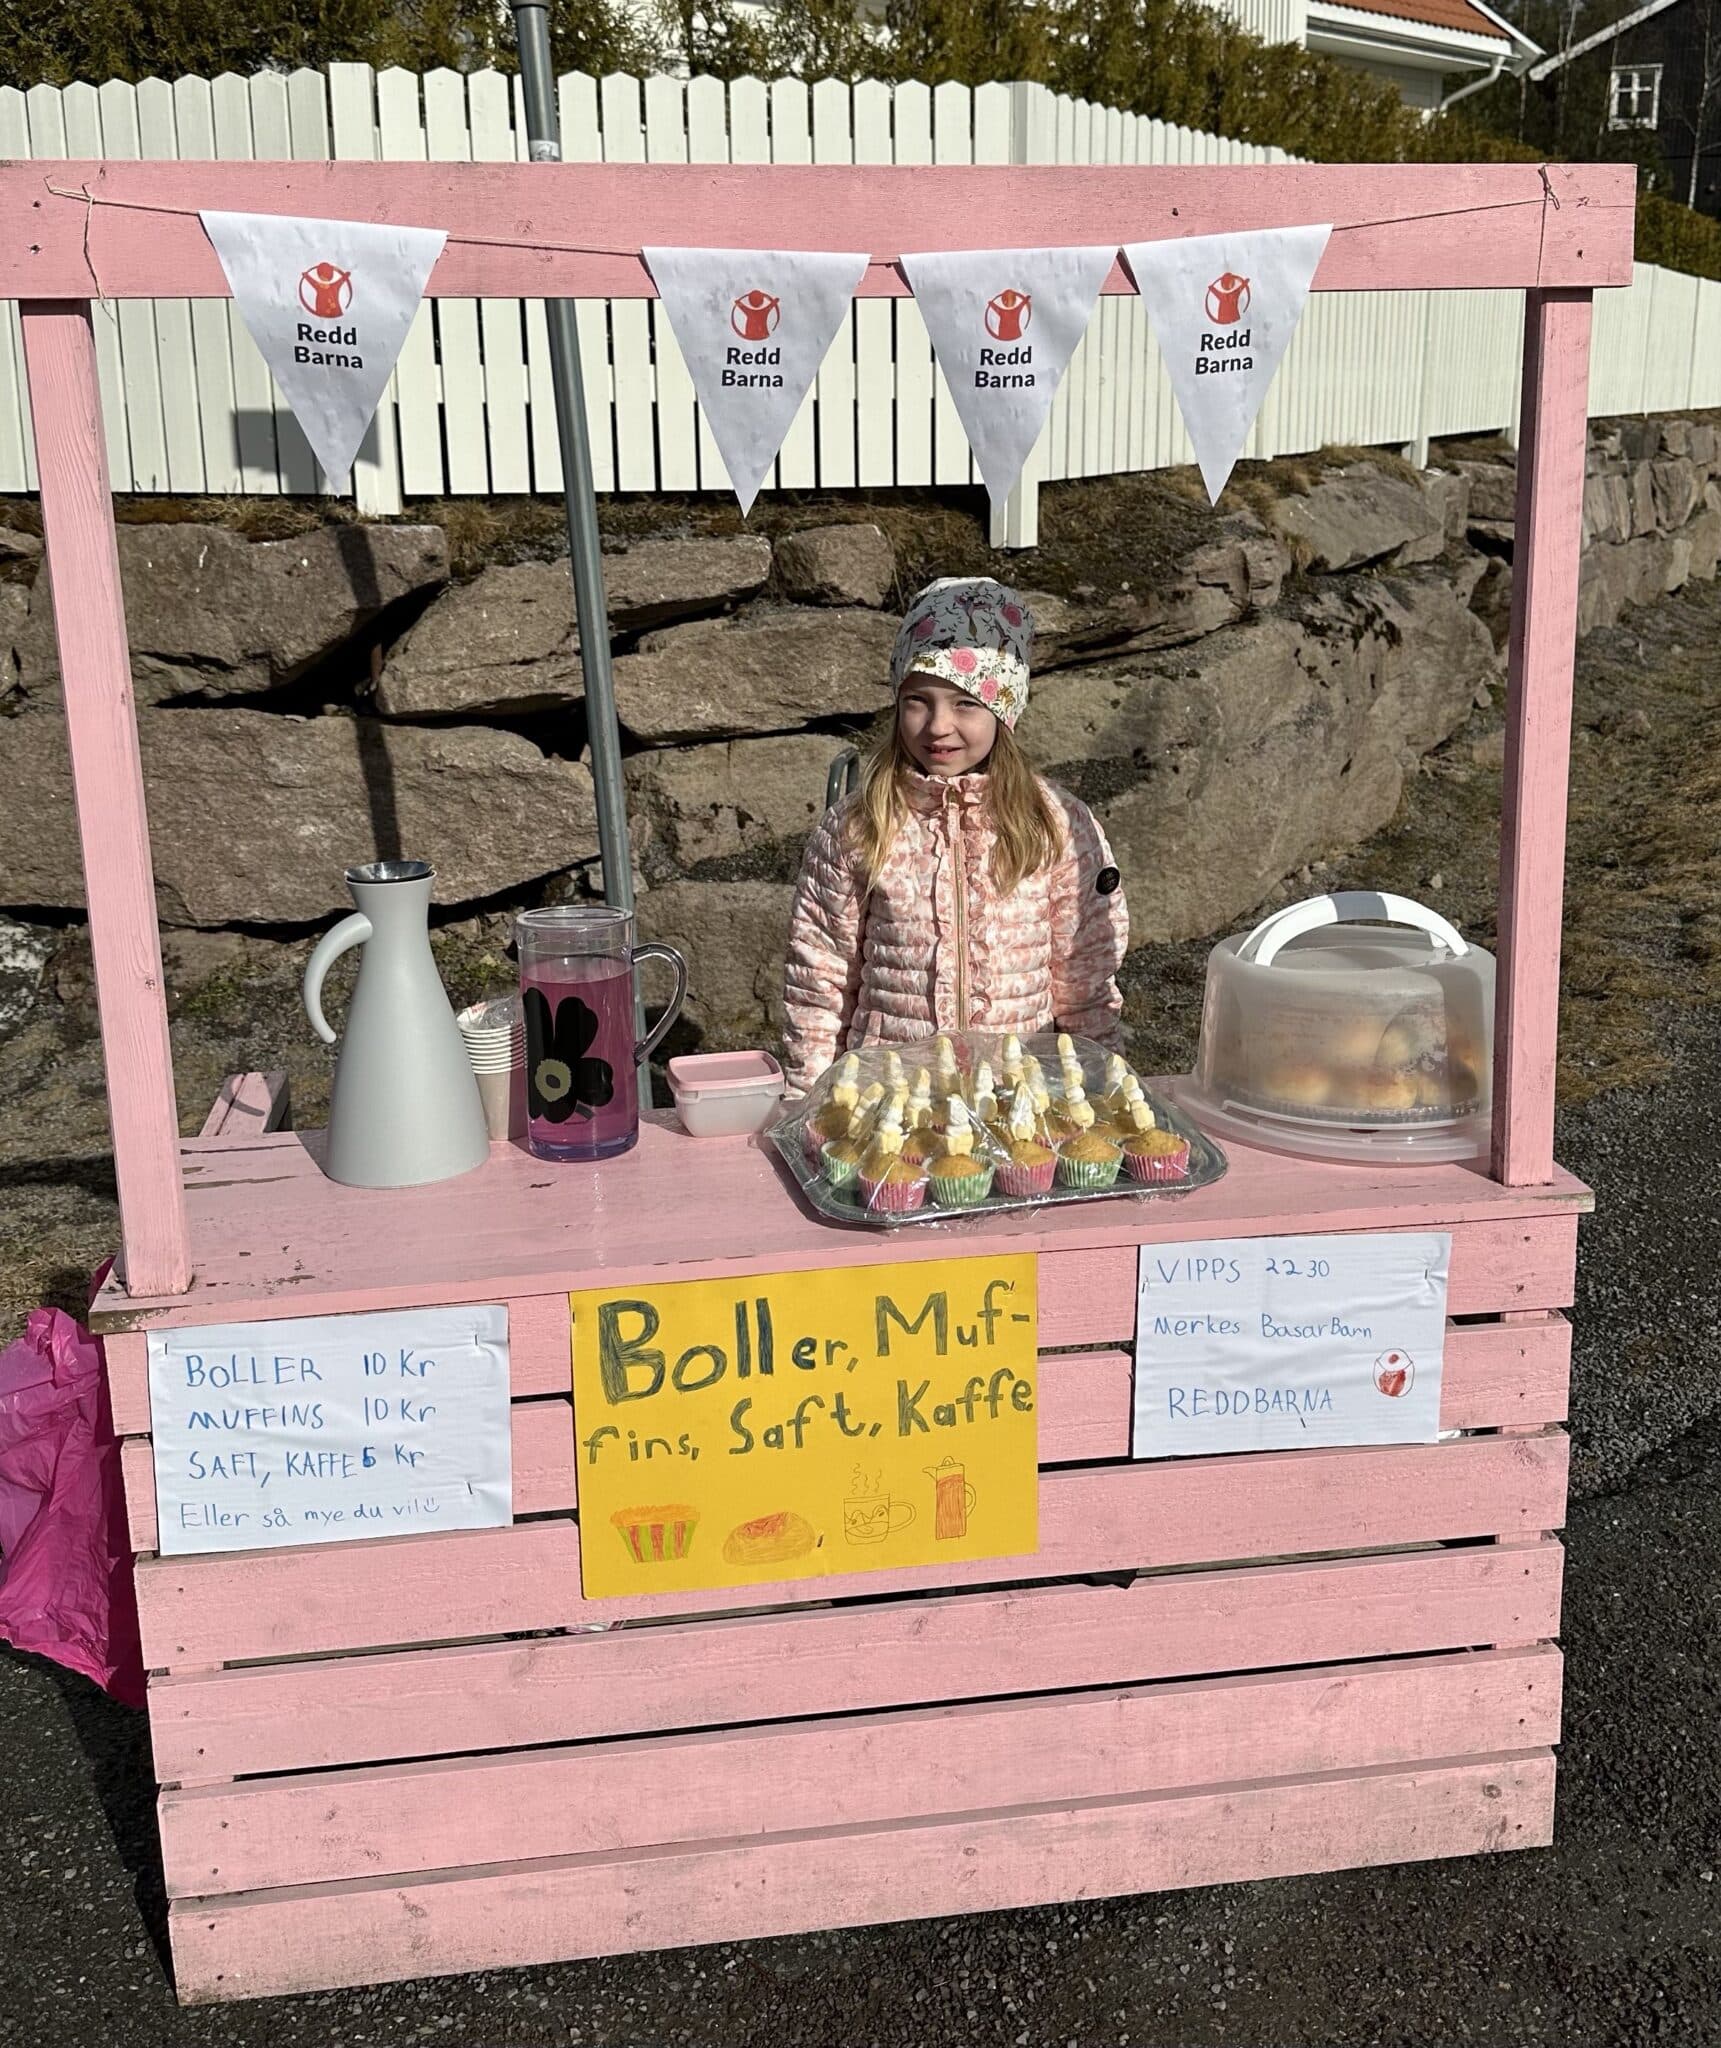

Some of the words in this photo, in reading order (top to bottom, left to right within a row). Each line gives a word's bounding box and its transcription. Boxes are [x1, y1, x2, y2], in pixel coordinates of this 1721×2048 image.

[296, 323, 358, 346] Redd
[1200, 330, 1252, 352] Redd
[294, 346, 364, 369] Barna
[726, 347, 781, 365] Redd
[979, 346, 1033, 365] Redd
[1195, 354, 1254, 376] Barna
[721, 369, 784, 388] Barna
[974, 370, 1036, 389] Barna
[1157, 1258, 1241, 1284] VIPPS
[1265, 1257, 1331, 1278] 2230
[598, 1297, 859, 1407] Boller,
[875, 1279, 1030, 1358] Muf-
[363, 1352, 387, 1377] 10
[400, 1348, 436, 1378] Kr
[187, 1403, 324, 1430] MUFFINS
[364, 1397, 389, 1427] 10
[400, 1401, 437, 1424] Kr
[1168, 1387, 1334, 1419] REDDBARNA
[582, 1425, 700, 1465] fins,
[728, 1391, 882, 1456] Saft,
[896, 1367, 1034, 1437] Kaffe
[188, 1450, 271, 1488] SAFT,
[286, 1450, 359, 1480] KAFFE
[394, 1443, 425, 1468] Kr
[180, 1502, 250, 1529] Eller
[262, 1508, 293, 1528] så
[304, 1508, 345, 1527] mye
[353, 1503, 383, 1518] du
